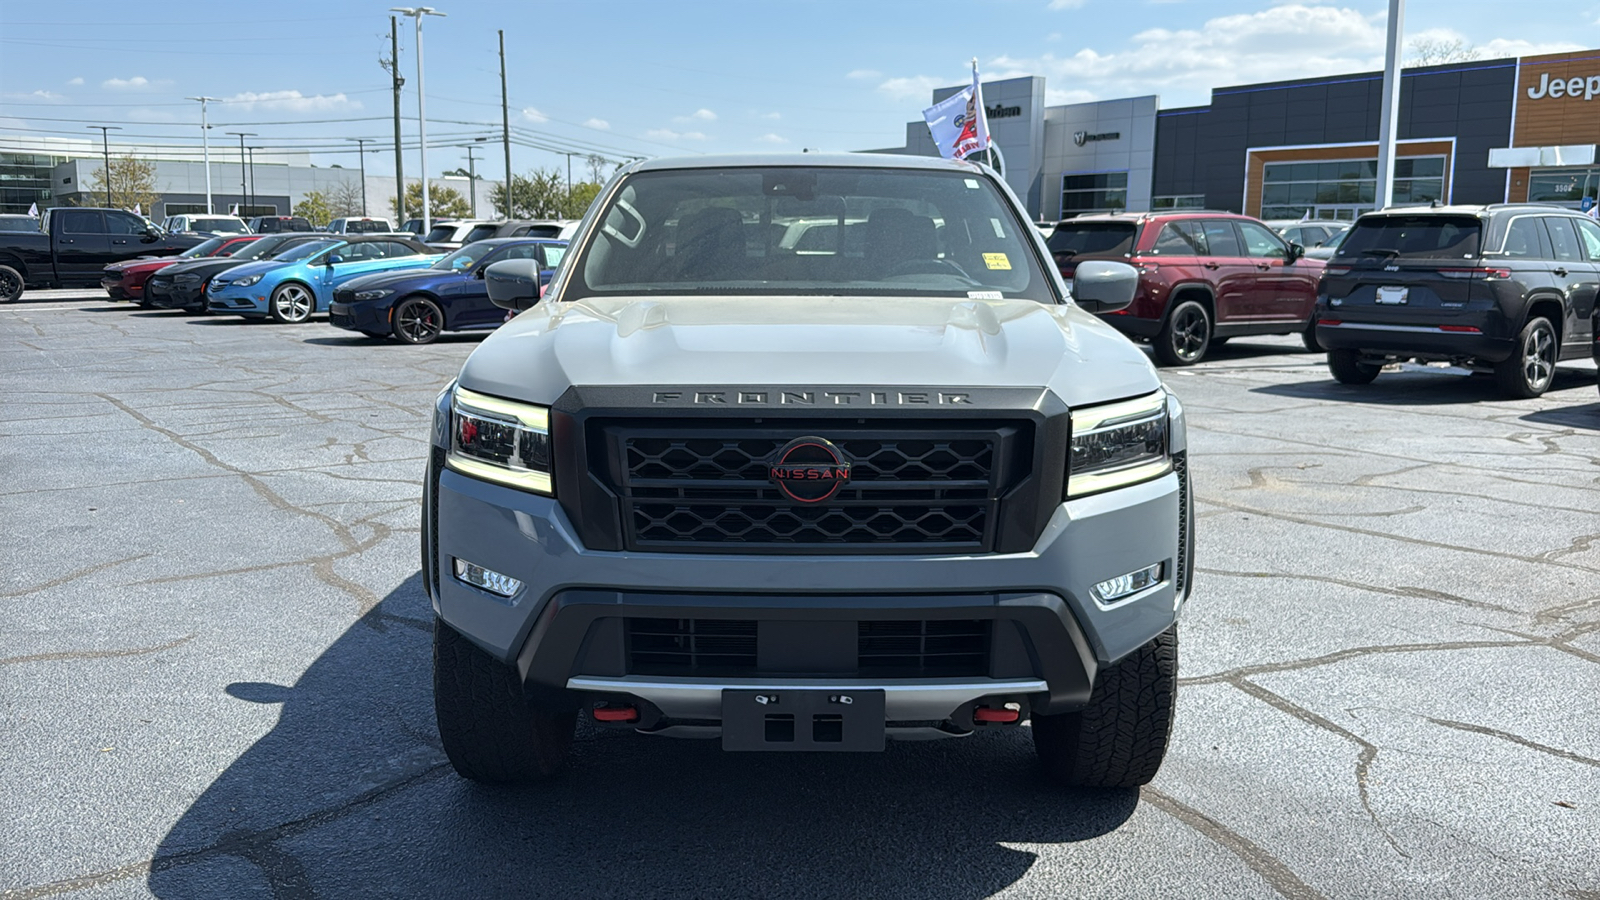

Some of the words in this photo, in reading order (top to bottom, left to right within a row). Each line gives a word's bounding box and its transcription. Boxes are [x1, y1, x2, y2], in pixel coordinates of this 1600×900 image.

[1527, 72, 1600, 100] Jeep
[651, 391, 973, 405] FRONTIER
[771, 468, 848, 479] NISSAN
